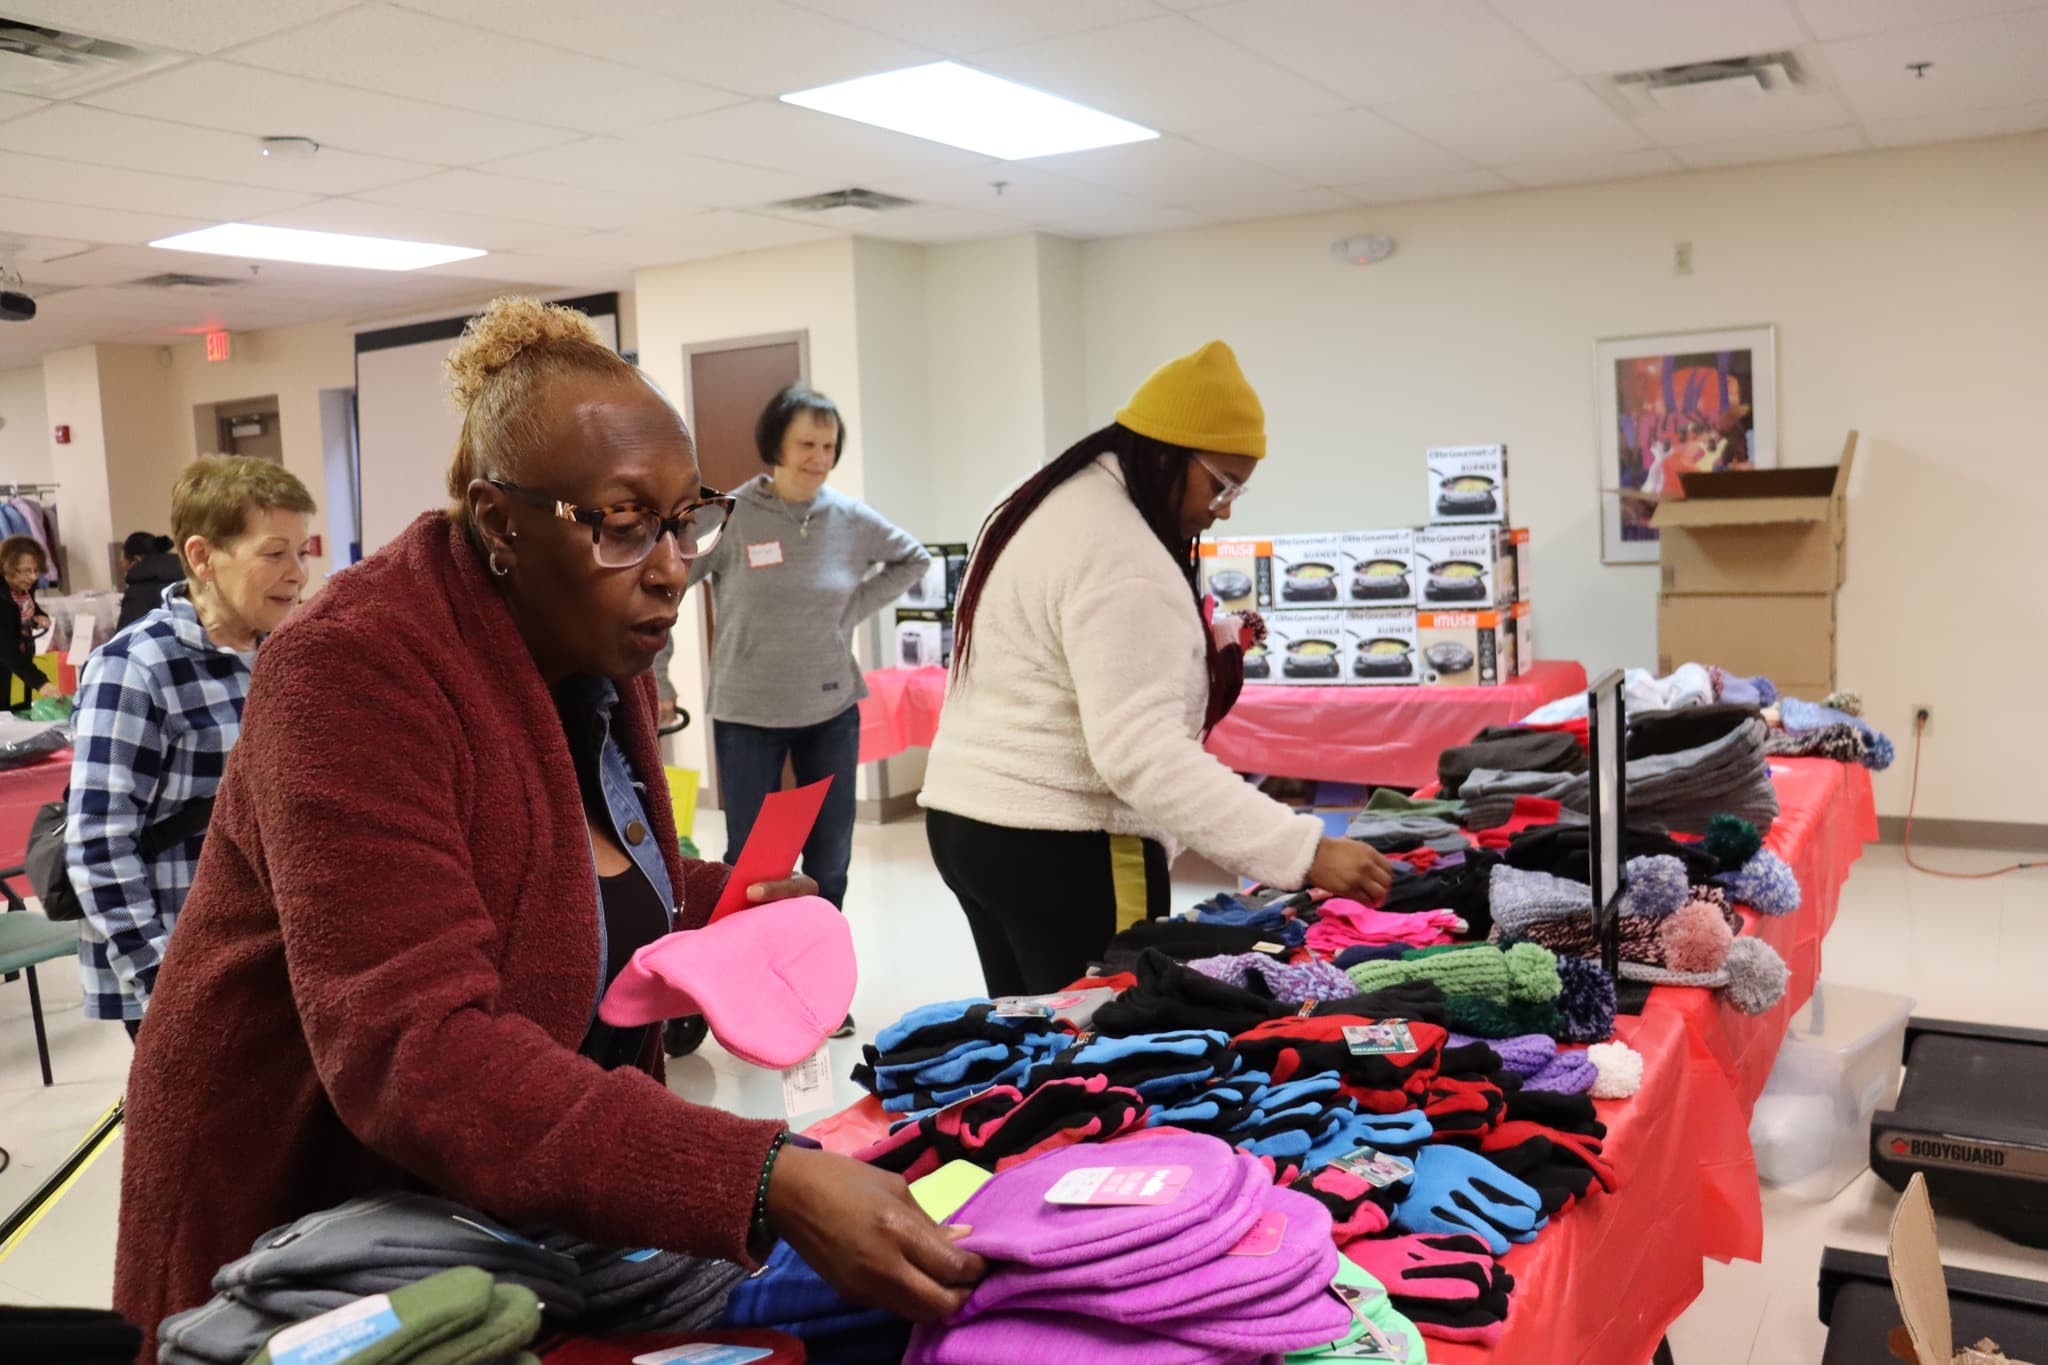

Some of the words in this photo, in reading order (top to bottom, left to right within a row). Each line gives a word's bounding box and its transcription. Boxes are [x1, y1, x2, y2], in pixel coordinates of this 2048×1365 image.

[207, 333, 228, 361] EXIT
[1461, 463, 1497, 472] BURNER
[1217, 543, 1256, 557] imusa
[1374, 548, 1410, 556] BURNER
[1449, 548, 1486, 557] BURNER
[1304, 551, 1337, 559] BURNER
[1433, 614, 1477, 627] imusa
[1305, 628, 1340, 636] BURNER
[1377, 626, 1413, 635] BURNER
[1911, 1139, 2004, 1166] BODYGUARD
